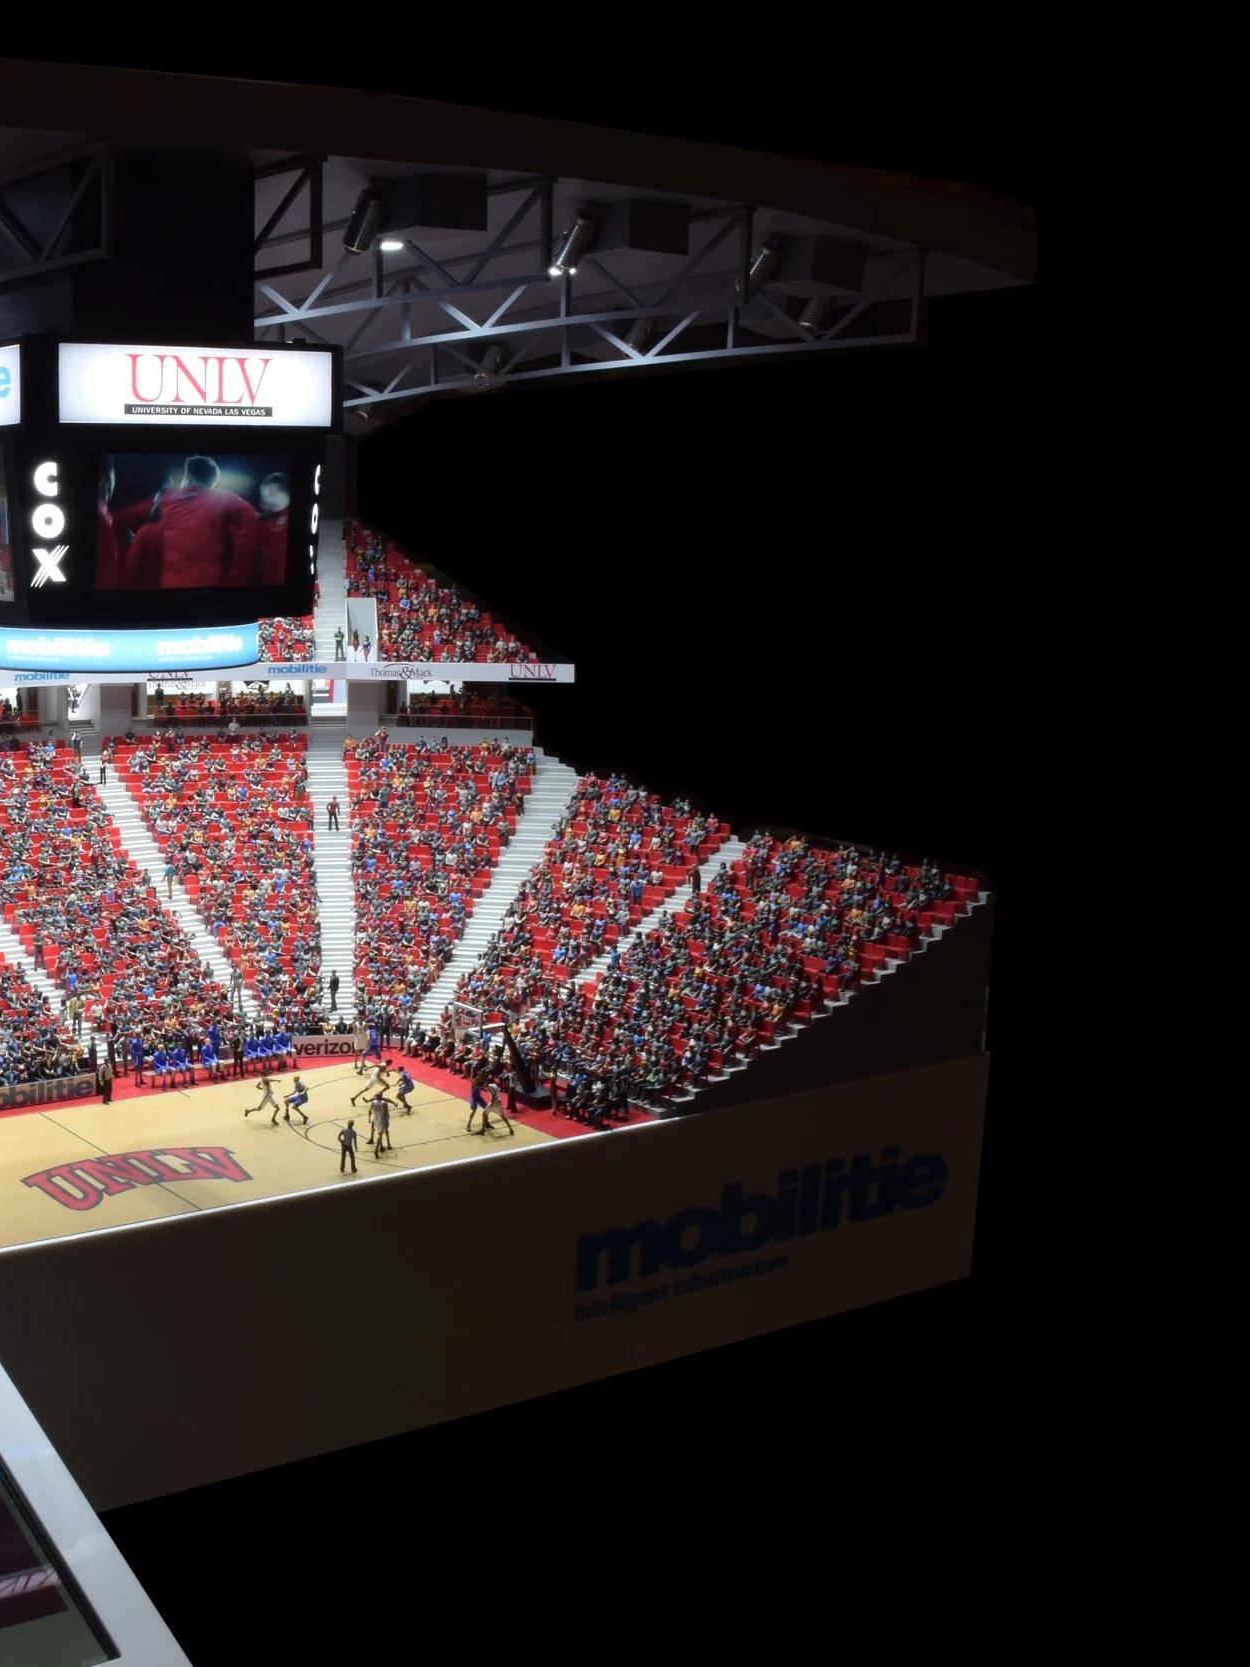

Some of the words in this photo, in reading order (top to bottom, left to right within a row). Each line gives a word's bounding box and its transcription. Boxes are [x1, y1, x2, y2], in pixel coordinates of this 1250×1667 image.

[125, 354, 273, 406] UNLV
[132, 406, 178, 414] UNIVERSITY
[180, 407, 191, 415] OF
[241, 408, 266, 416] VEGAS
[30, 461, 69, 588] COX
[7, 636, 111, 657] mobilitie
[268, 664, 327, 675] mobilitie
[510, 664, 556, 678] UNLV
[20, 1146, 254, 1211] UNLV
[574, 1144, 948, 1293] mobilitie
[574, 1283, 669, 1321] intelligent
[673, 1256, 788, 1296] infrastructure
